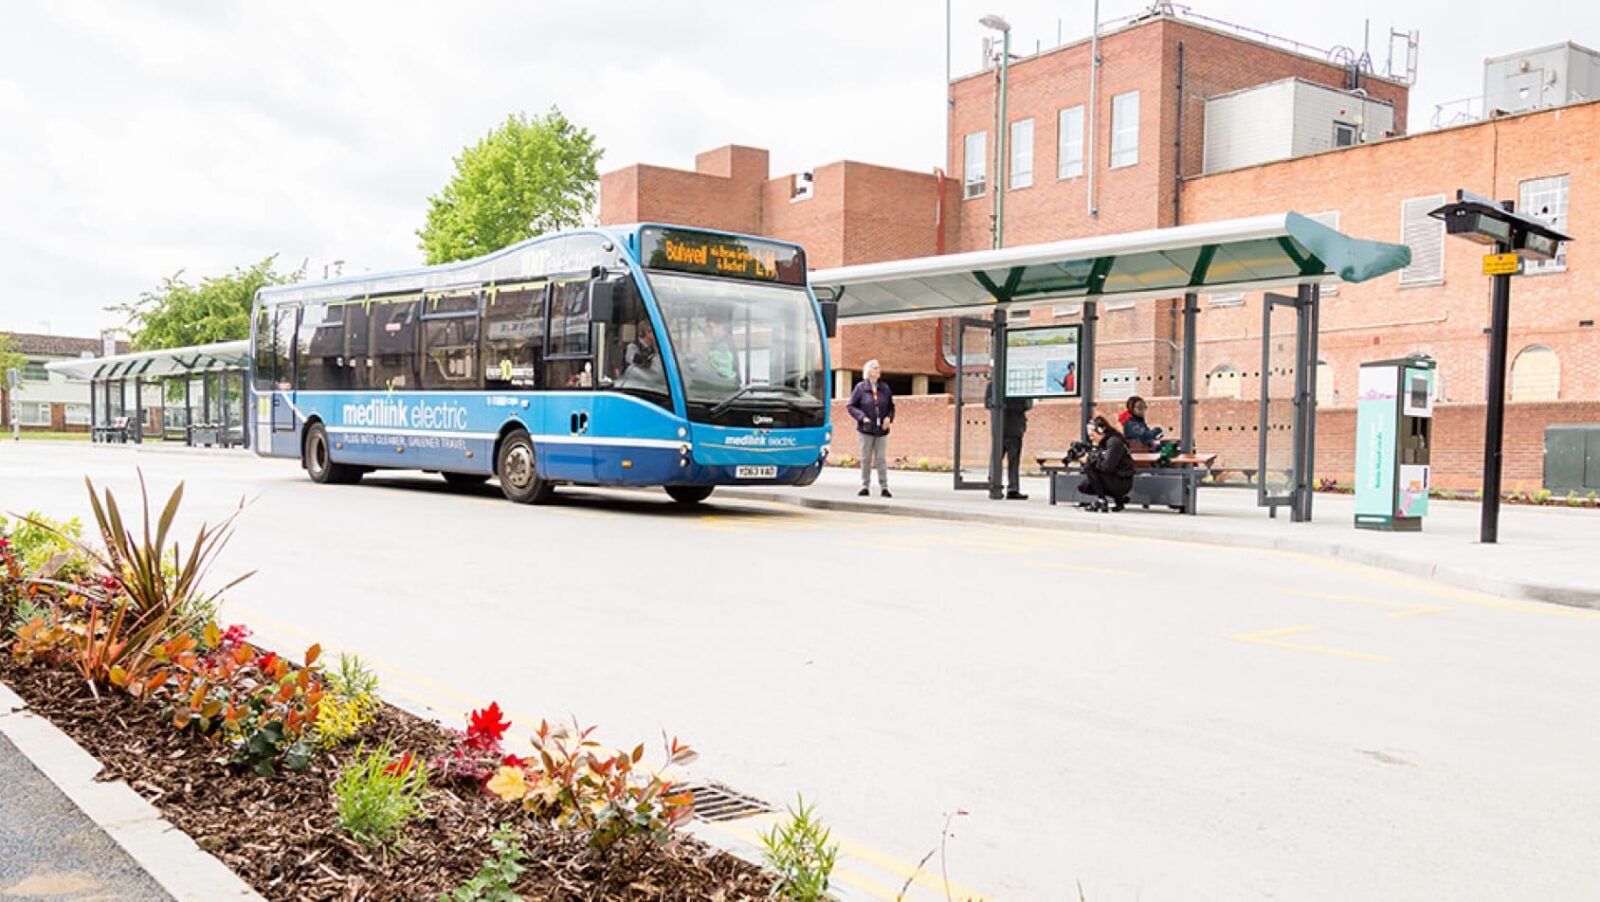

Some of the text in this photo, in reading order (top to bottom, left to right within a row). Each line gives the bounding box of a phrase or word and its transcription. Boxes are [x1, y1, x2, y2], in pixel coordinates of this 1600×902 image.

[665, 240, 708, 265] Bulwell
[343, 399, 467, 430] medilink electric
[343, 433, 359, 444] PLUG
[361, 434, 374, 444] INTO
[408, 436, 440, 448] GREENER
[441, 437, 467, 450] TRAVEL
[725, 435, 796, 446] medilink electric
